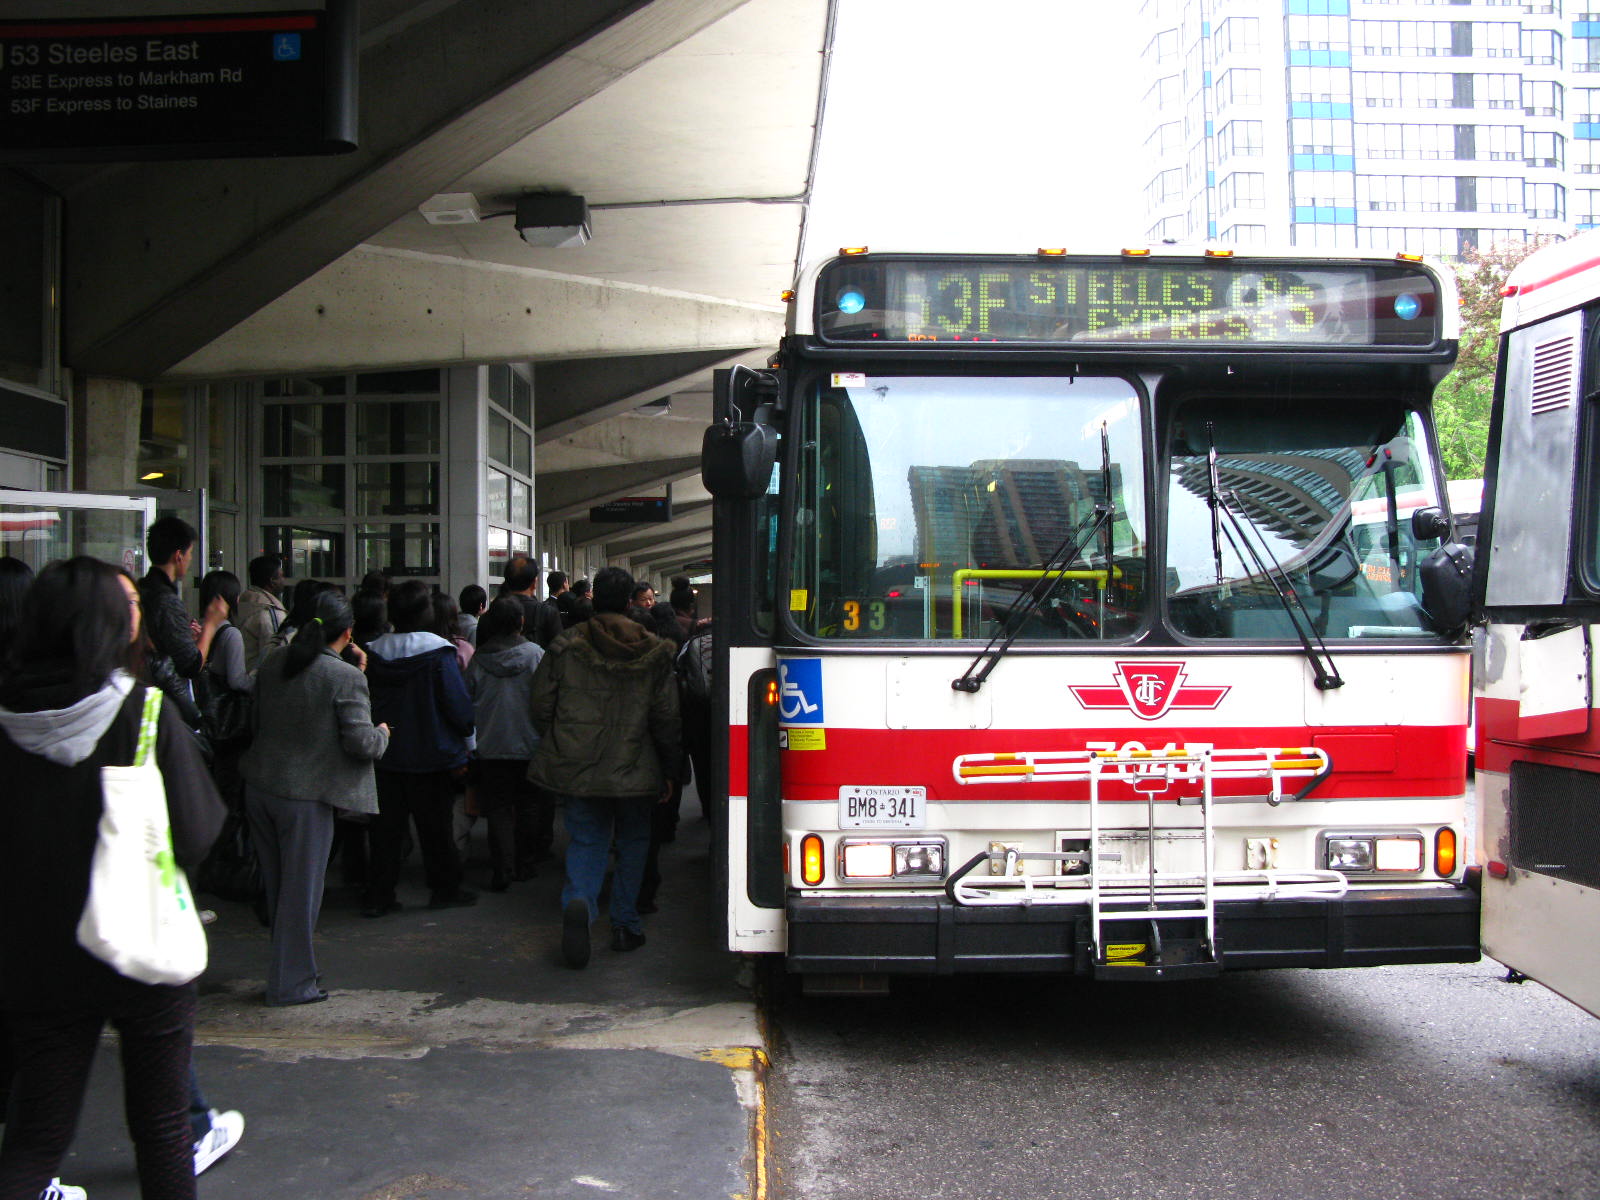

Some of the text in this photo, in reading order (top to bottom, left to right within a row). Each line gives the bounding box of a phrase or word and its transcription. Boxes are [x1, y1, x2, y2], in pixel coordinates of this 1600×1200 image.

[10, 40, 200, 66] 53 Steeles East
[10, 67, 242, 92] 53E Express to Markham Rd
[10, 94, 198, 115] 53F Express to Staines
[1029, 270, 1214, 306] STEELES
[1088, 308, 1278, 340] EXPRESS
[865, 788, 900, 796] ONTARIO
